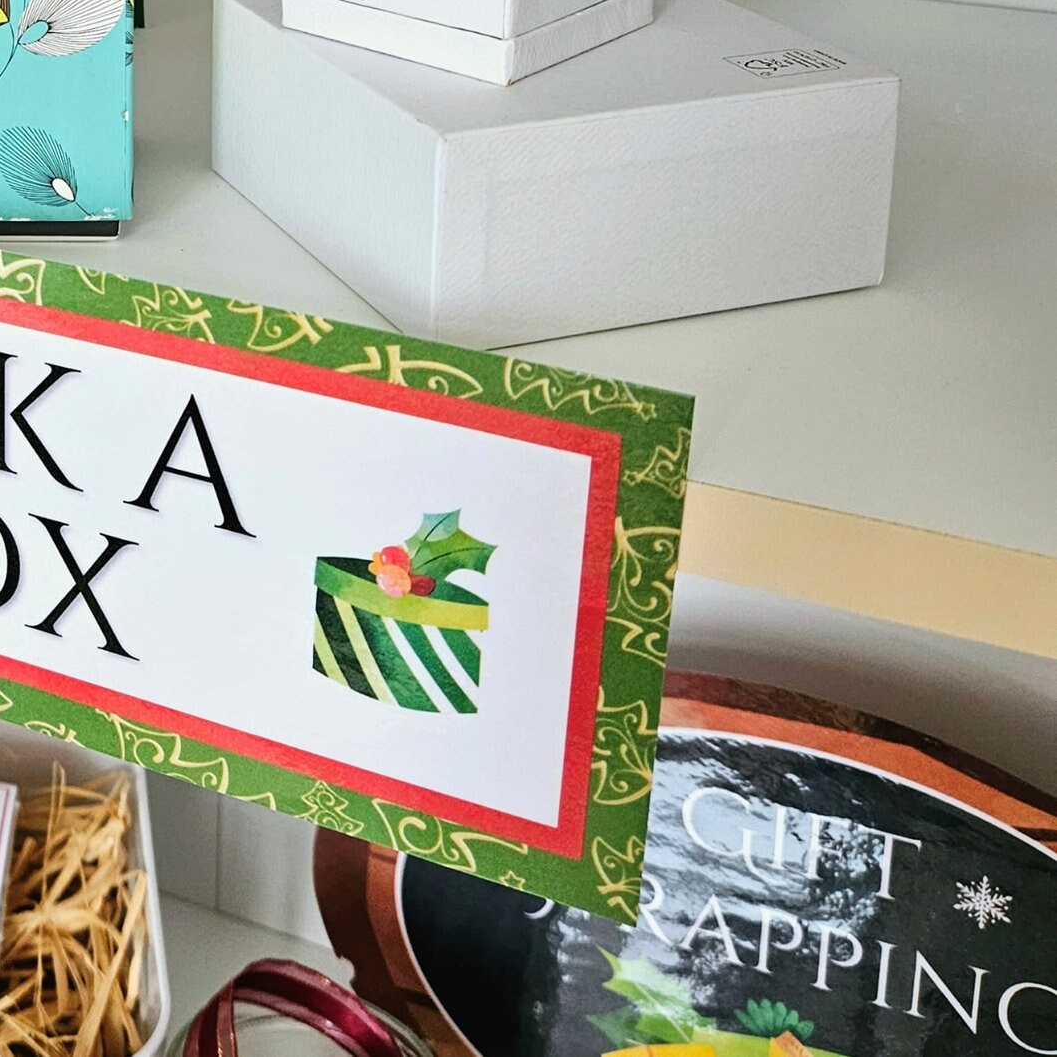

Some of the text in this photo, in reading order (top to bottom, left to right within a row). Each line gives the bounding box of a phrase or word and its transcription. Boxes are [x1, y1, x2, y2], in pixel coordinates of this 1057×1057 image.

[123, 393, 257, 539] A
[681, 787, 923, 901] GIFT
[524, 873, 1057, 1056] RAPPING
